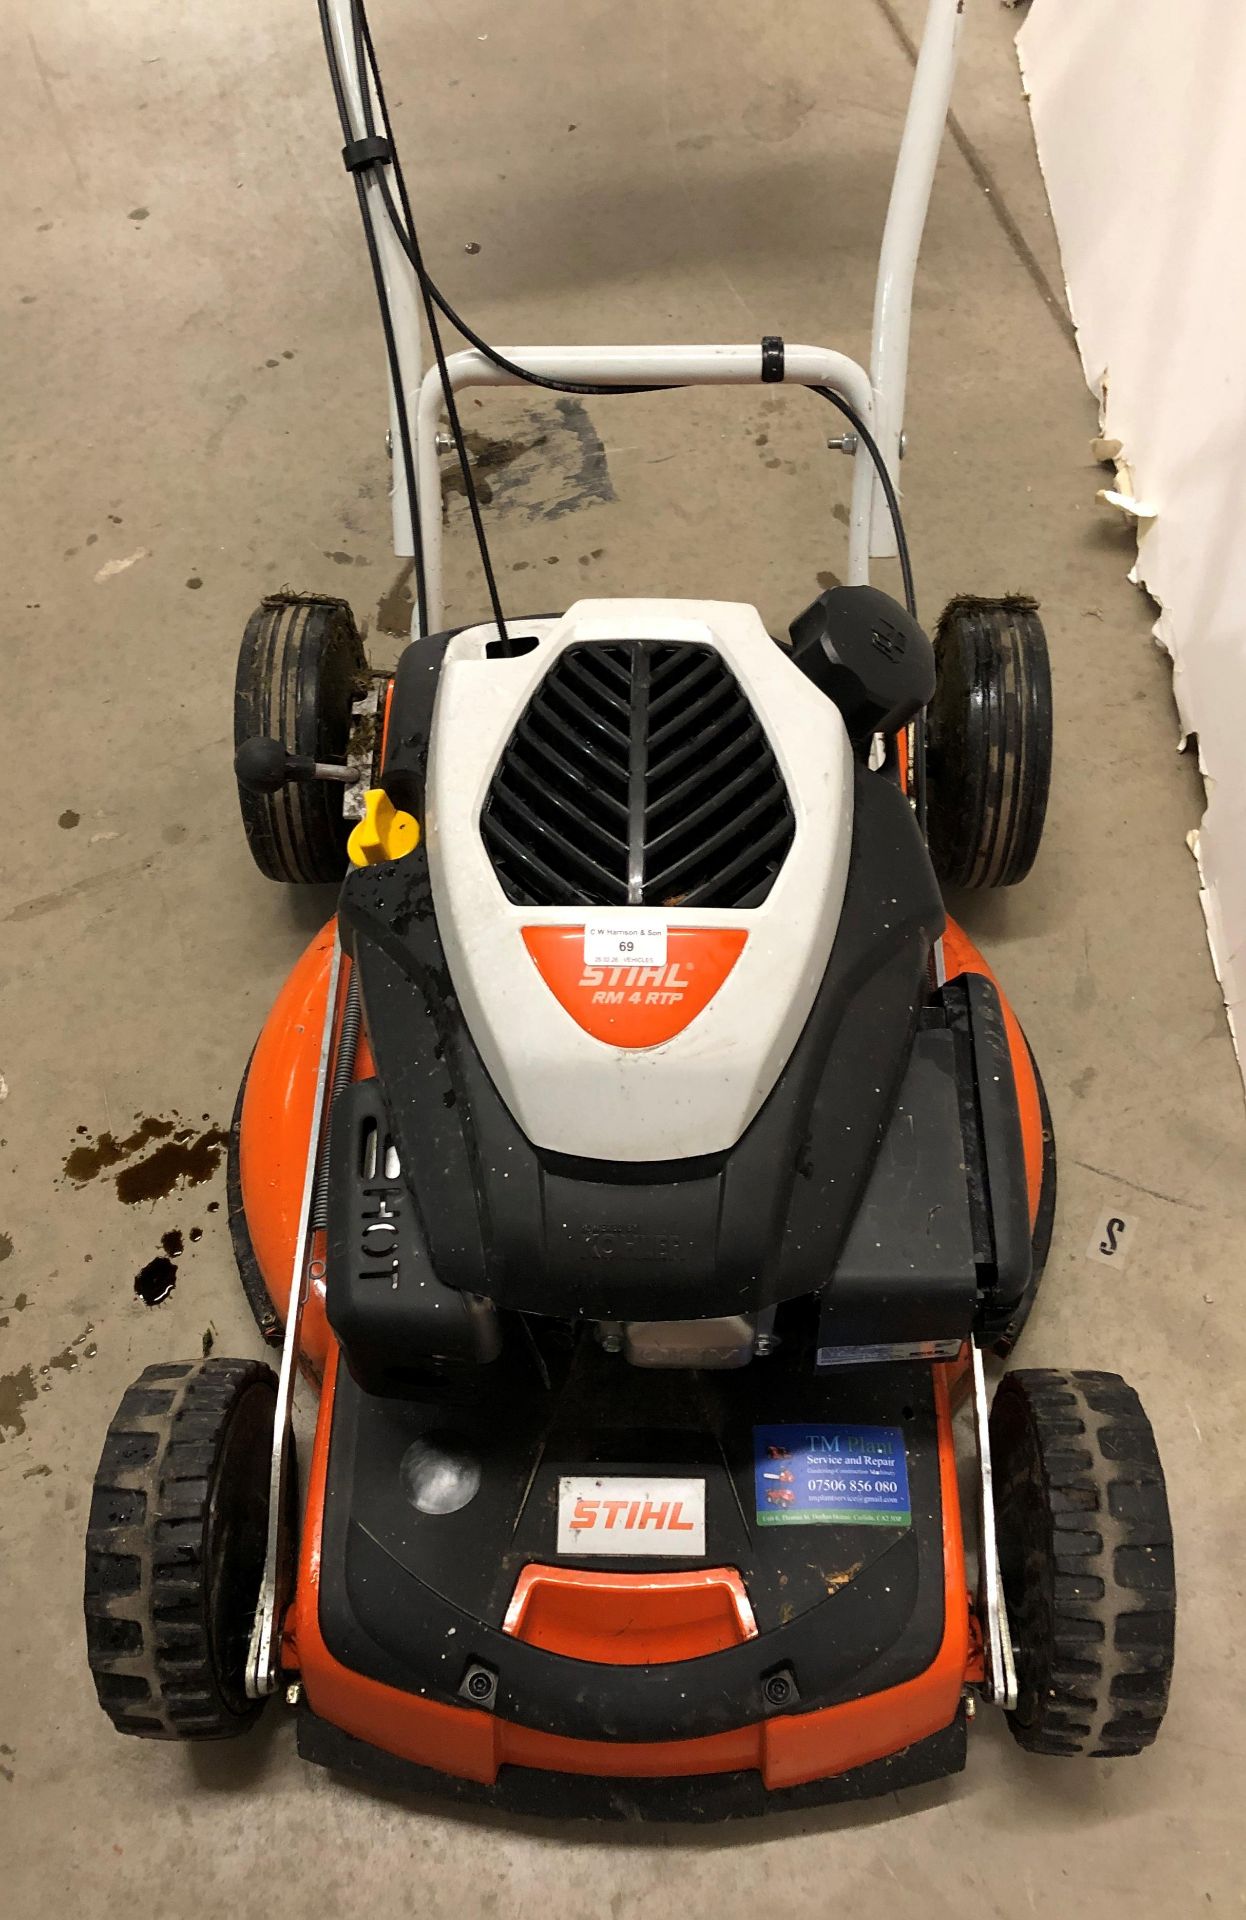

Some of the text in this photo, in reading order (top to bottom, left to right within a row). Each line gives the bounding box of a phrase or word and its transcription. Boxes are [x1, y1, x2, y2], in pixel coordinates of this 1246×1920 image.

[619, 941, 634, 952] 69
[578, 964, 689, 988] STIHL
[592, 991, 684, 1005] RM 4 RTP
[359, 1188, 401, 1289] HOT
[806, 1435, 893, 1455] TM Plant
[807, 1455, 896, 1468] Service and Repair
[808, 1479, 898, 1493] 07506 856 080
[569, 1500, 694, 1530] STIHL
